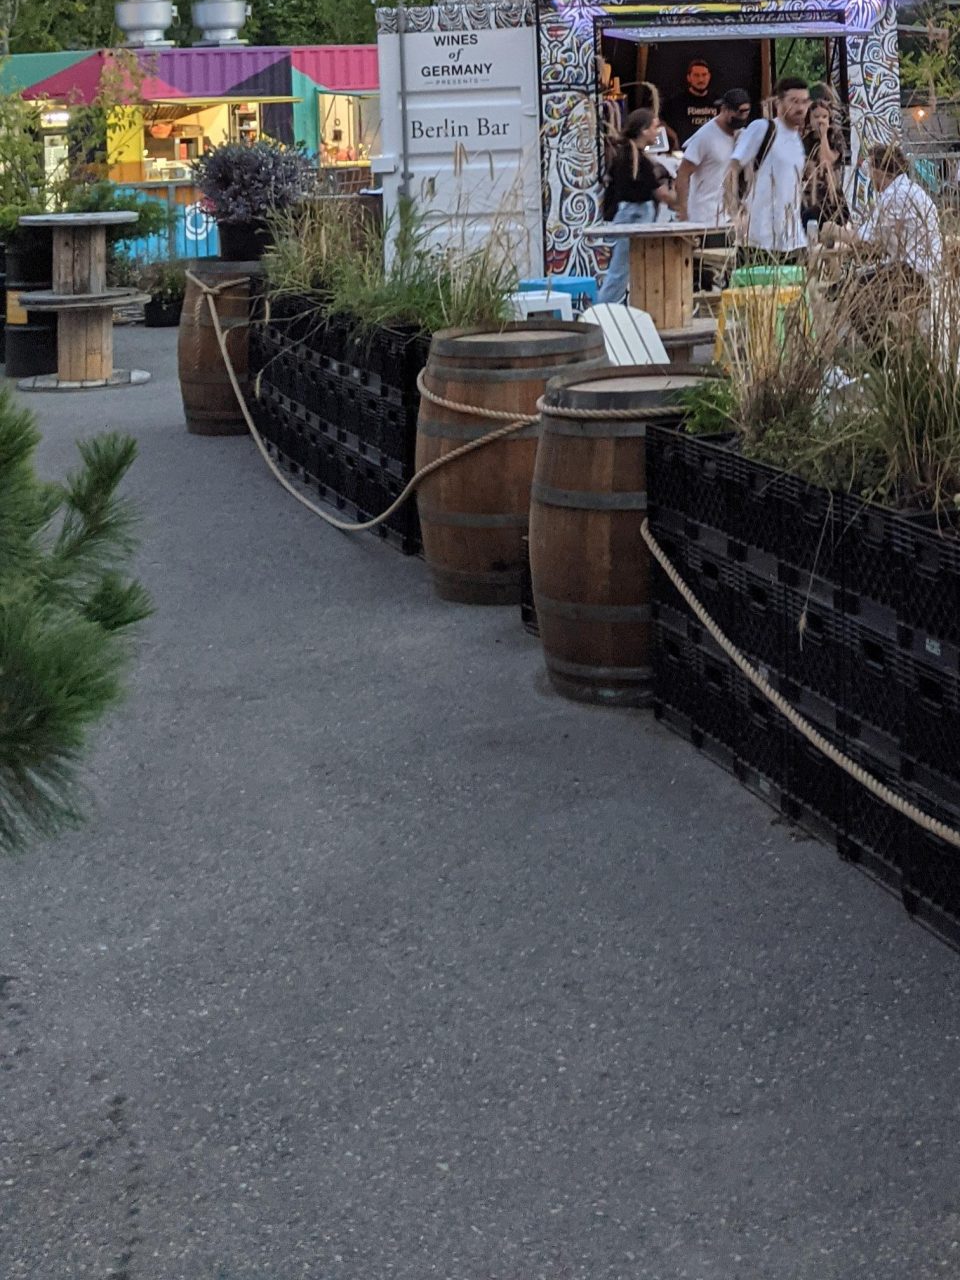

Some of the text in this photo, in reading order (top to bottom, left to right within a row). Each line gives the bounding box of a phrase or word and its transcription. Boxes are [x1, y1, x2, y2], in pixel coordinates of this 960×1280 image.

[434, 33, 478, 47] WINES
[448, 48, 463, 62] of
[421, 63, 492, 77] GERMANY
[410, 117, 510, 139] Berlin Bar
